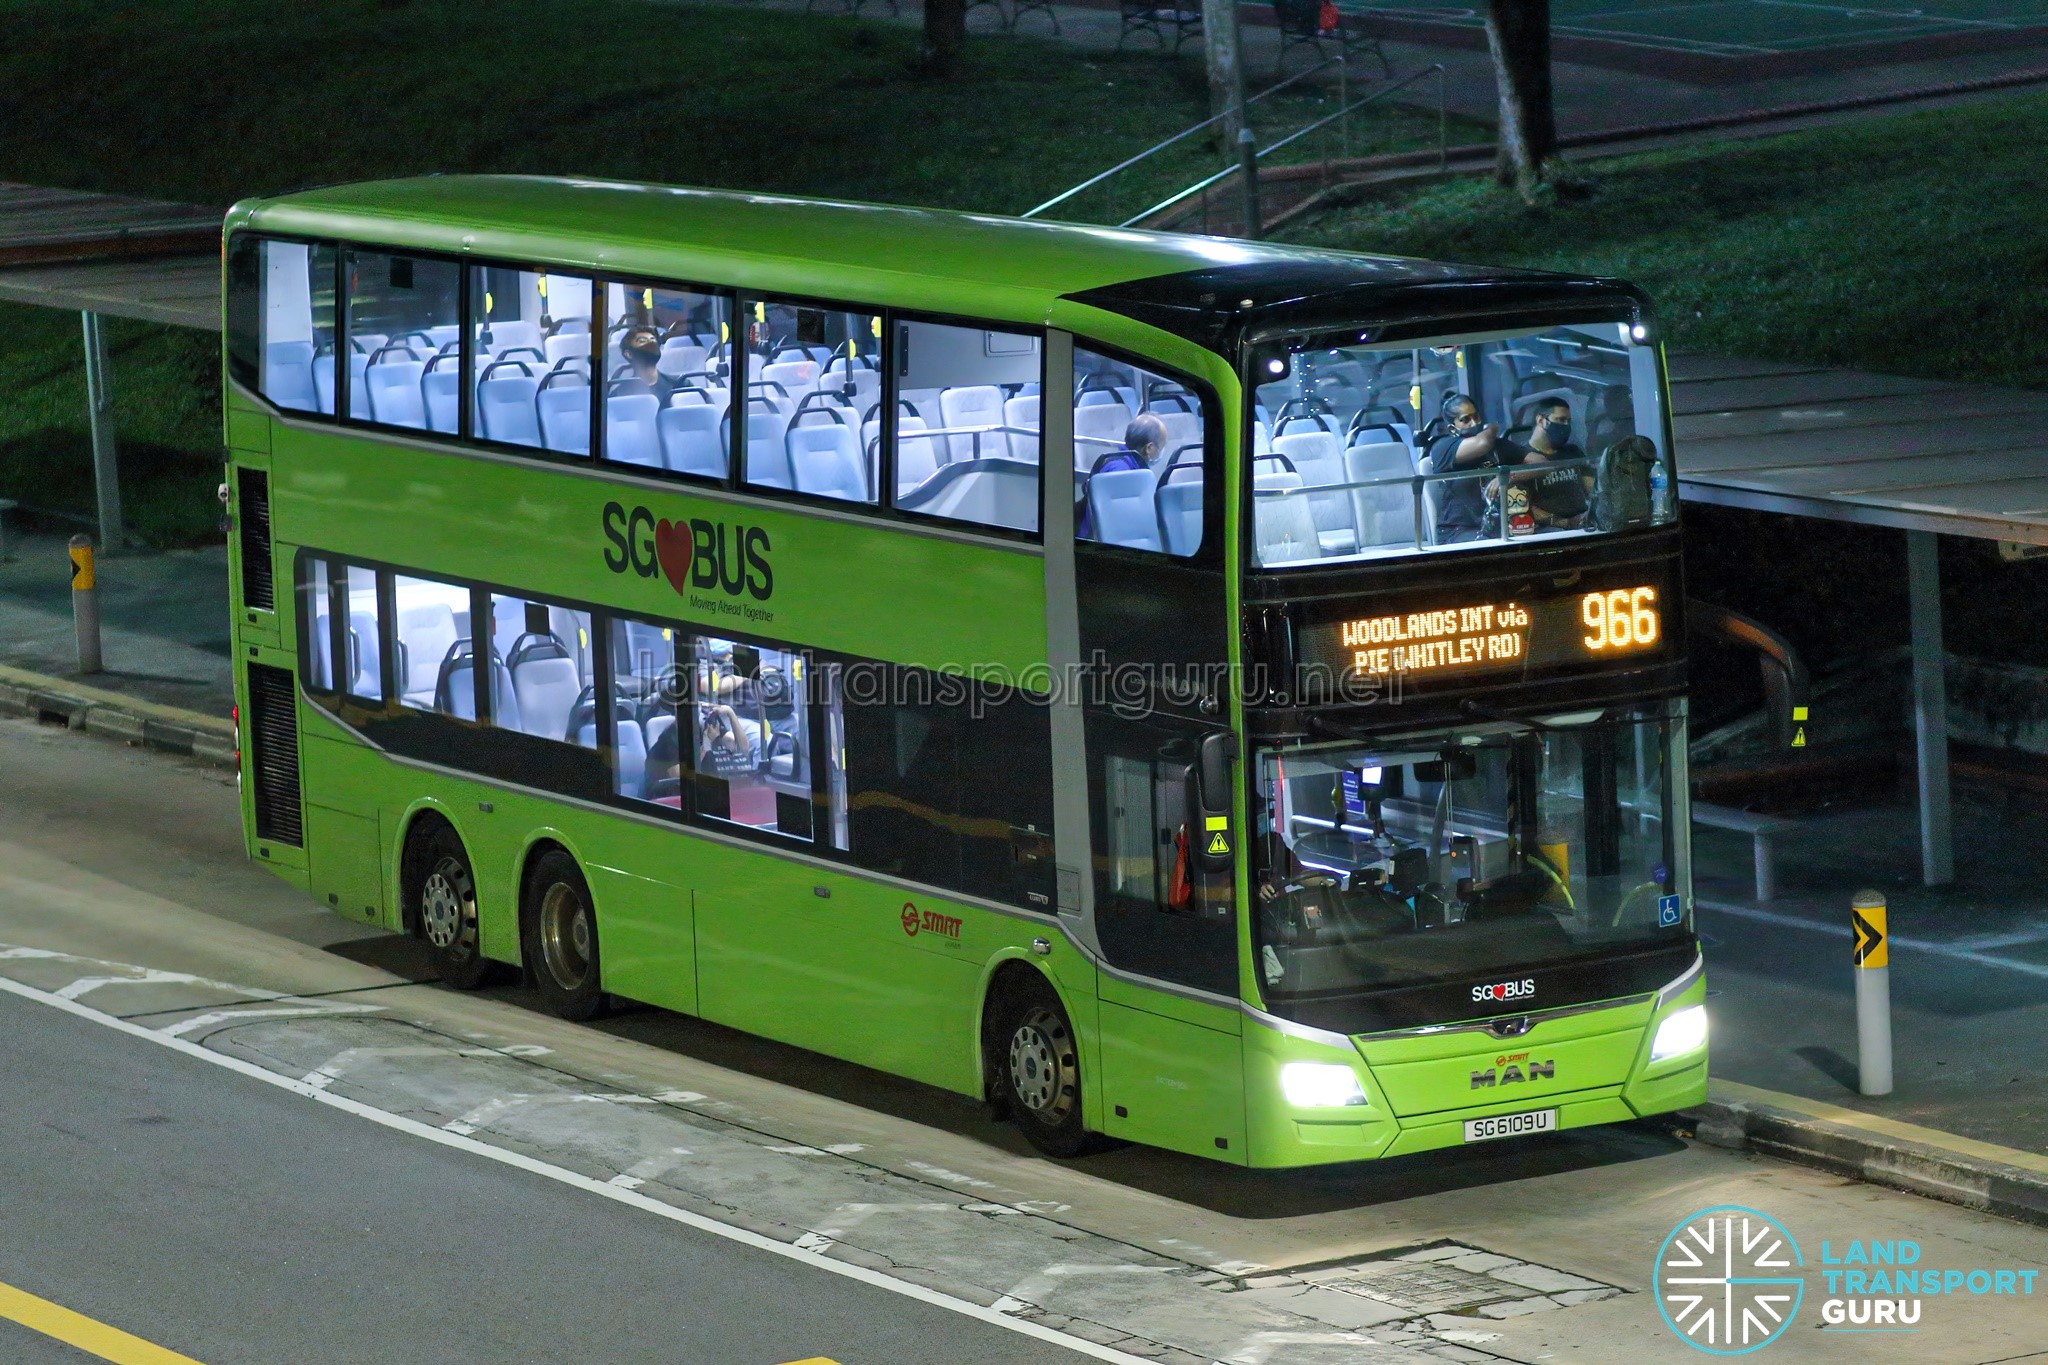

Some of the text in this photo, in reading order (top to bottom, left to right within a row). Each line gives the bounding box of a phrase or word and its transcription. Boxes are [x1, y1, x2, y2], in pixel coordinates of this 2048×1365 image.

[689, 594, 774, 622] Moving Ahead Together
[1581, 586, 1659, 650] 966
[1342, 602, 1528, 646] WOODLANDS INT via
[1354, 648, 1389, 676] PIE
[1488, 632, 1521, 660] RD)
[921, 910, 963, 938] SMRT
[1470, 1059, 1555, 1090] MAN
[1474, 1112, 1547, 1138] SG6109U
